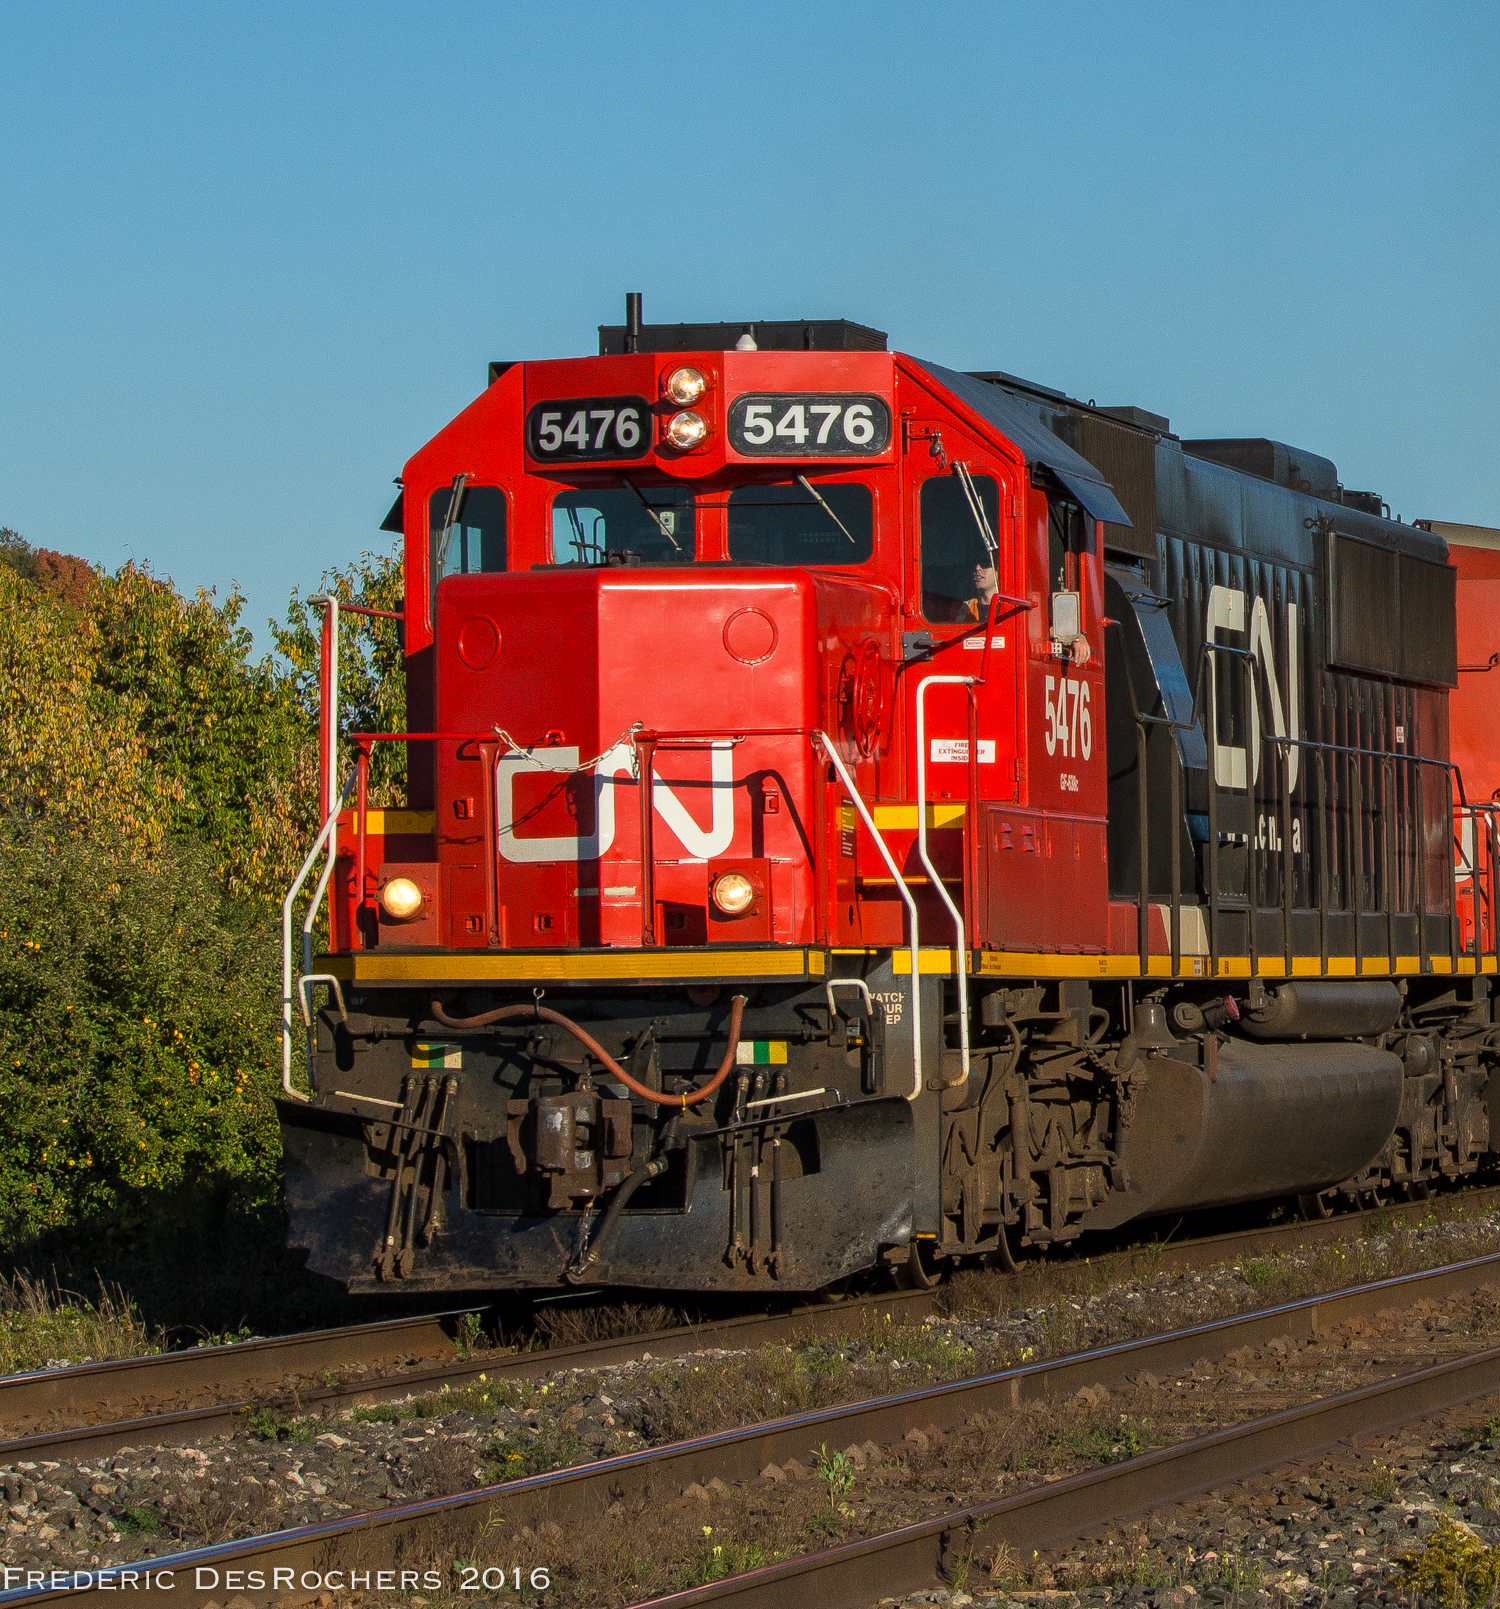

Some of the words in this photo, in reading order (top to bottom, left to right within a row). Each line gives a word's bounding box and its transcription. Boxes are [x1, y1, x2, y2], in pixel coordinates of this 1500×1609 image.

[539, 407, 641, 451] 5476
[742, 404, 875, 445] 5476
[1045, 674, 1092, 762] 5476
[1206, 584, 1299, 795] CN
[496, 741, 735, 863] CN
